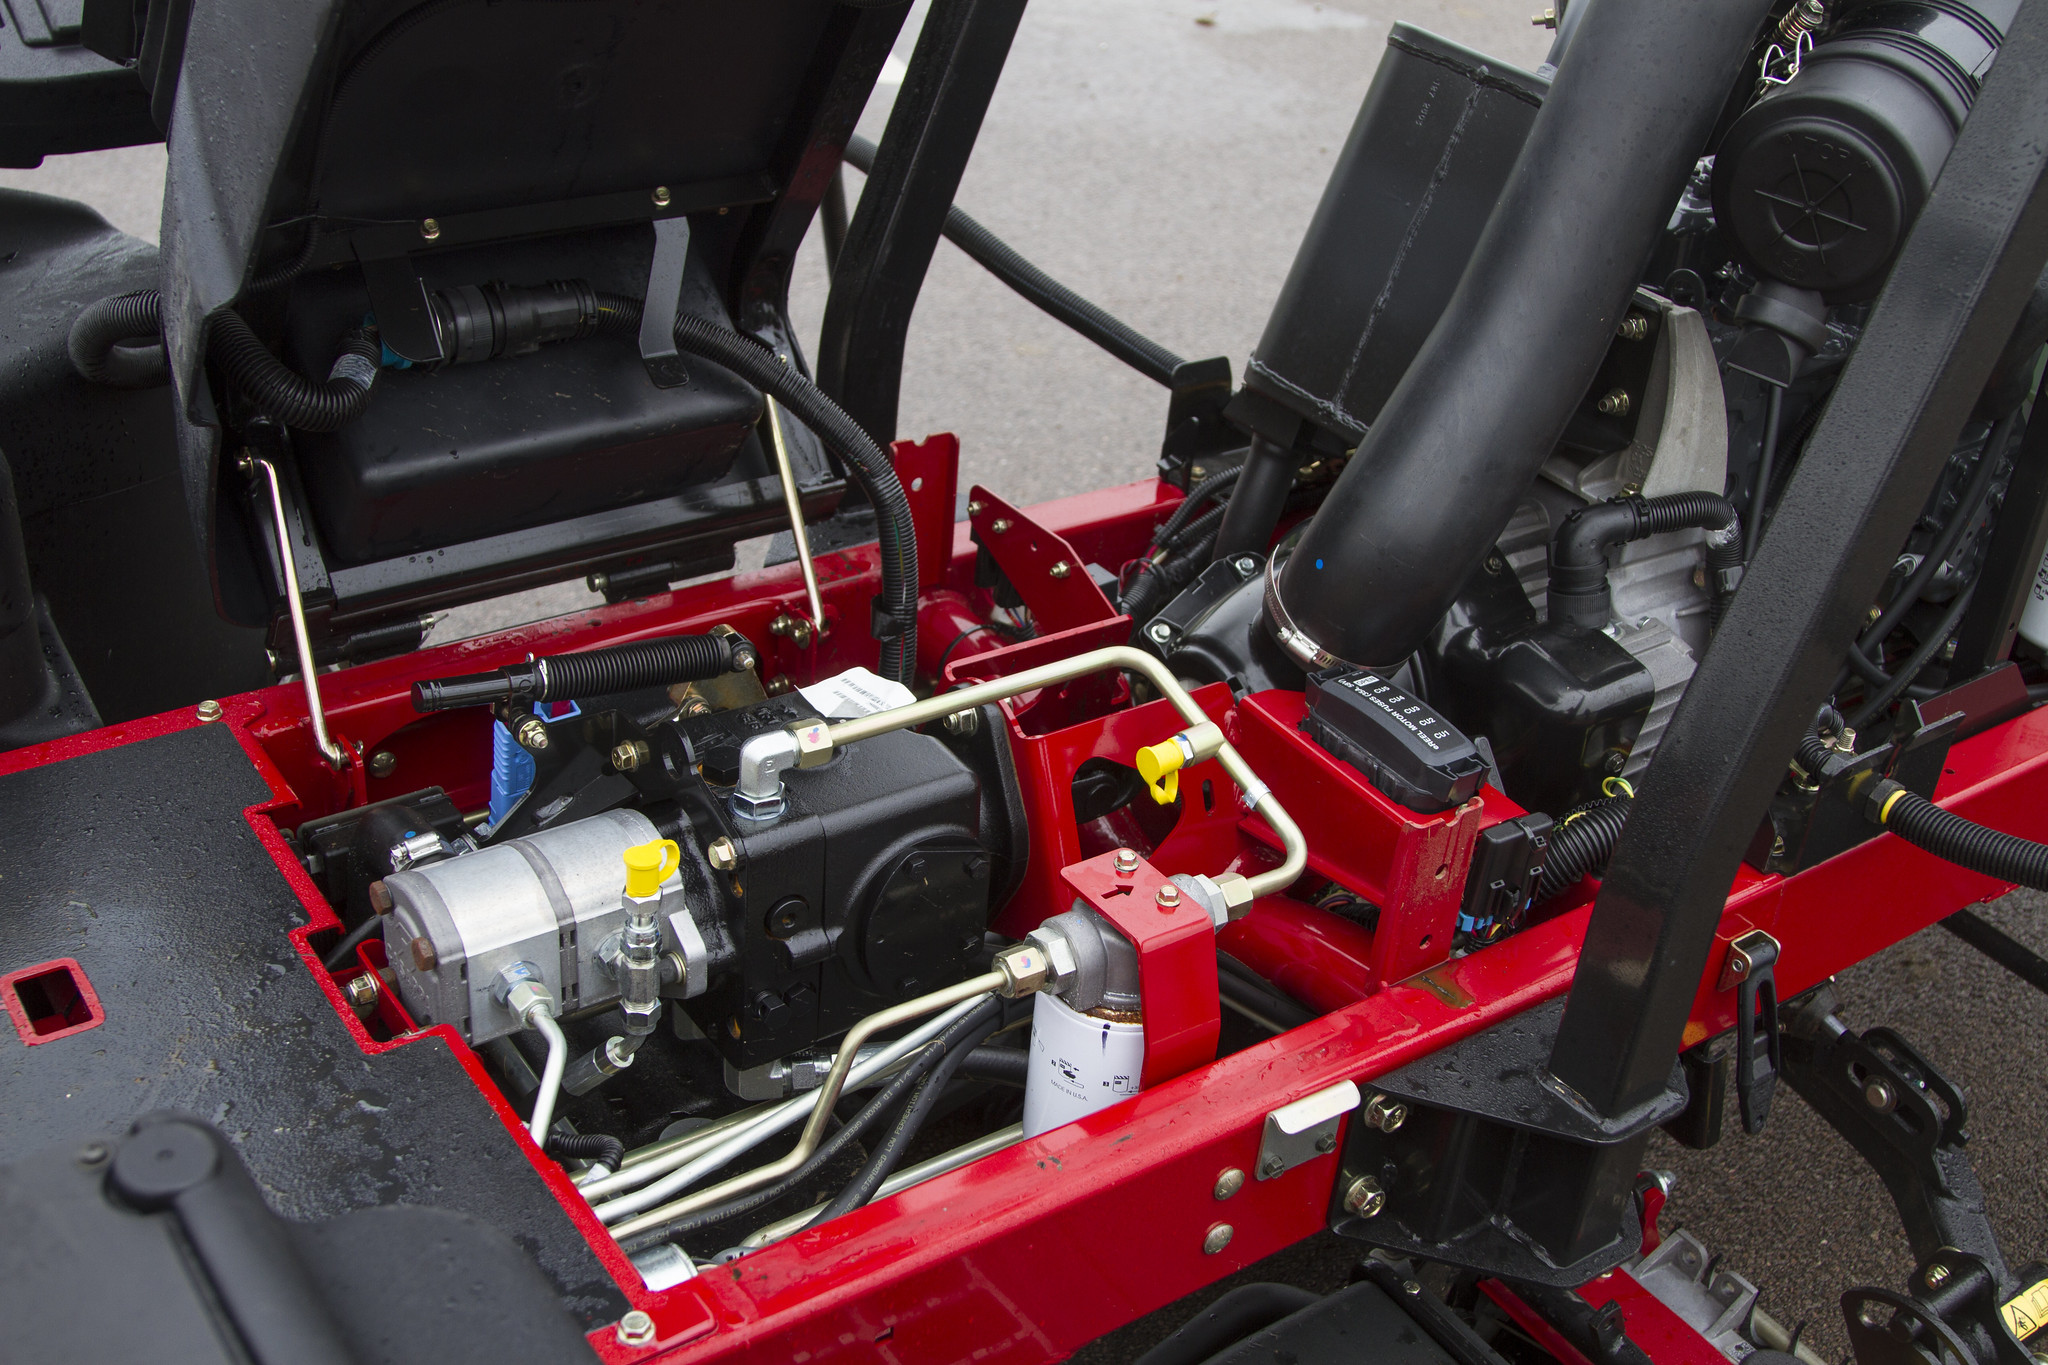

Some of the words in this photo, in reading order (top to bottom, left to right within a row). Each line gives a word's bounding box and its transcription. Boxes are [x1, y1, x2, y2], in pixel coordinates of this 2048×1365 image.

[1369, 696, 1393, 713] FUSES
[1388, 695, 1406, 704] CU4
[1403, 705, 1420, 714] CU3
[1391, 711, 1418, 732] MOTOR
[1418, 717, 1436, 726] CU2
[1417, 729, 1440, 750] eREEL
[1433, 729, 1450, 739] CU1
[894, 1069, 913, 1088] 3/16
[1050, 1079, 1066, 1093] MADE
[883, 1091, 894, 1101] ID
[864, 1101, 882, 1121] AVON
[829, 1120, 863, 1155] GREENBAR
[861, 1154, 888, 1193] STANDARD
[885, 1137, 897, 1153] LOW
[894, 1091, 920, 1135] PERMEATION
[789, 1154, 828, 1186] STANDARD
[769, 1184, 787, 1198] LOW
[706, 1196, 766, 1223] PERMEATION
[676, 1221, 701, 1233] FUEL
[642, 1230, 670, 1245] HOSE
